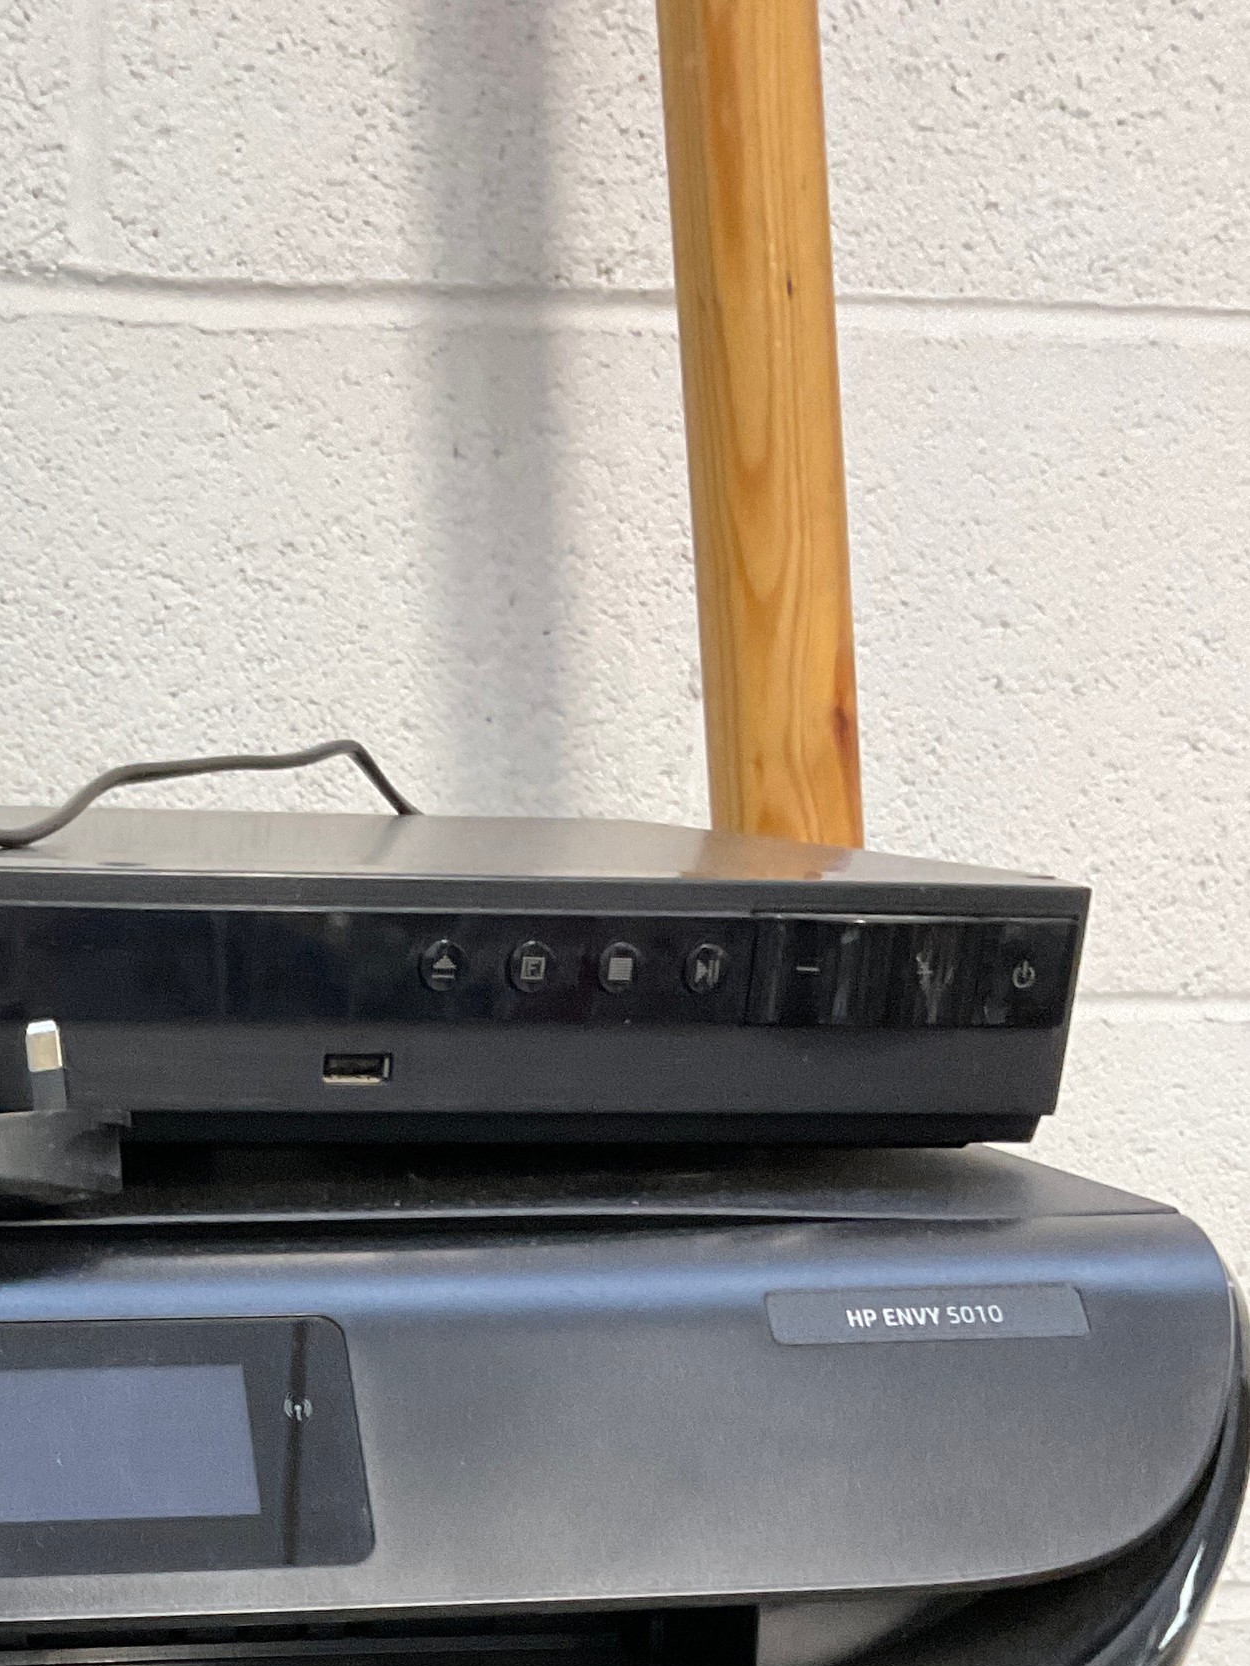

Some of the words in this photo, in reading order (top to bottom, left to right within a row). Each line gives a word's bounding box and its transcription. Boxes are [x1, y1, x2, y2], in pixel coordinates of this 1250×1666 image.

[846, 1307, 878, 1328] HP
[882, 1306, 940, 1327] ENVY
[946, 1304, 1004, 1325] 5010
